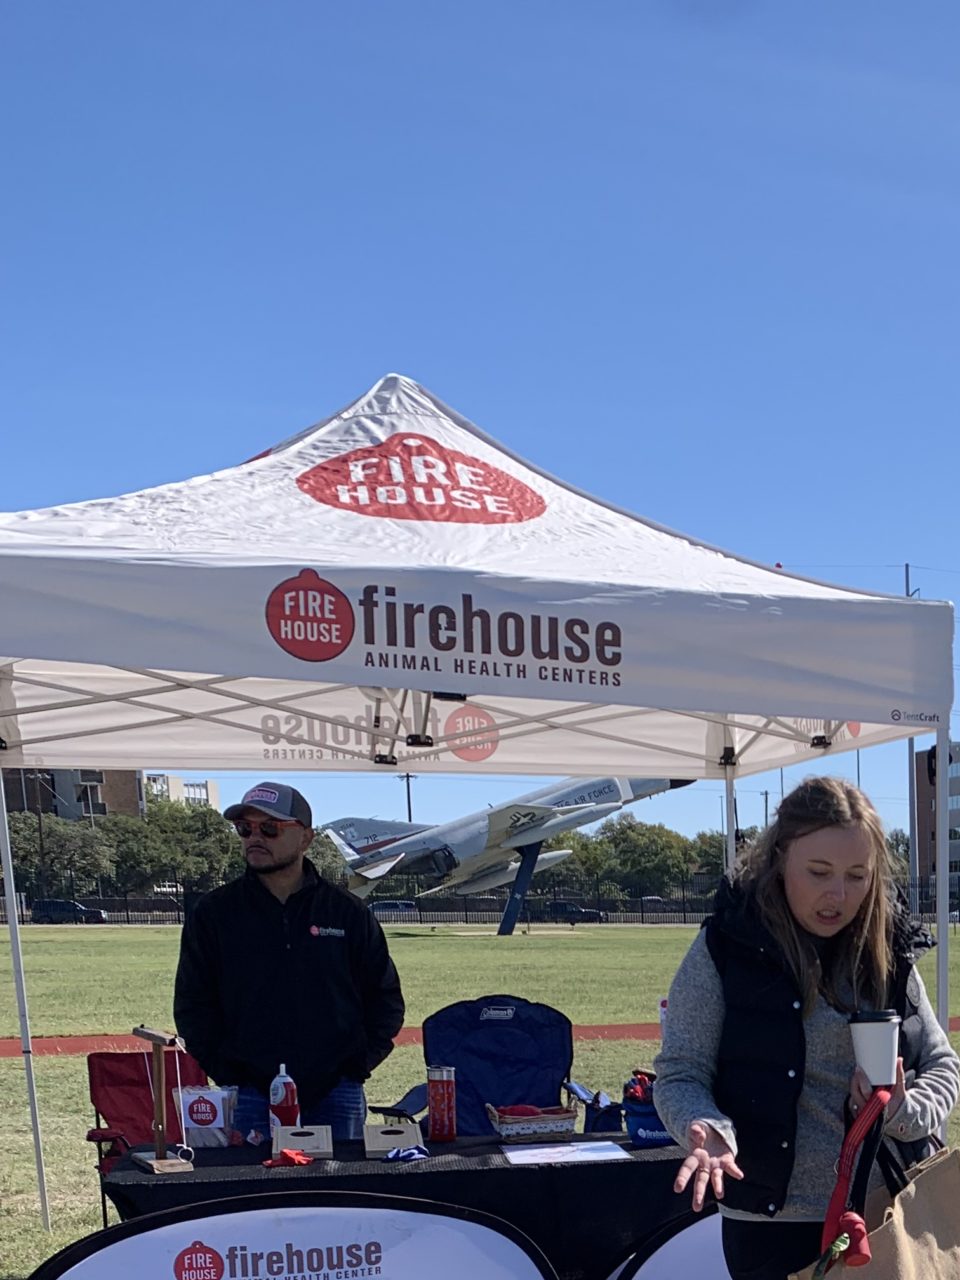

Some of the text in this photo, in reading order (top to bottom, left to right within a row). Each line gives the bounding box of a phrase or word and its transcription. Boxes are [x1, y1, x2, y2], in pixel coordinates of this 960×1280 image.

[348, 455, 493, 491] FIRE
[336, 485, 515, 515] HOUSE
[283, 590, 336, 620] FIRE
[279, 619, 342, 644] HOUSE
[358, 585, 622, 667] firehouse
[364, 652, 622, 687] ANIMAL HEALTH CENTERS
[903, 711, 940, 722] TentCraft
[364, 833, 379, 844] 712
[192, 1112, 214, 1120] HOUSE
[193, 1103, 211, 1113] FIRE
[184, 1253, 214, 1268] FIRE
[225, 1241, 382, 1278] firehouse
[181, 1268, 218, 1280] HOUSE
[335, 1266, 382, 1280] CENTER
